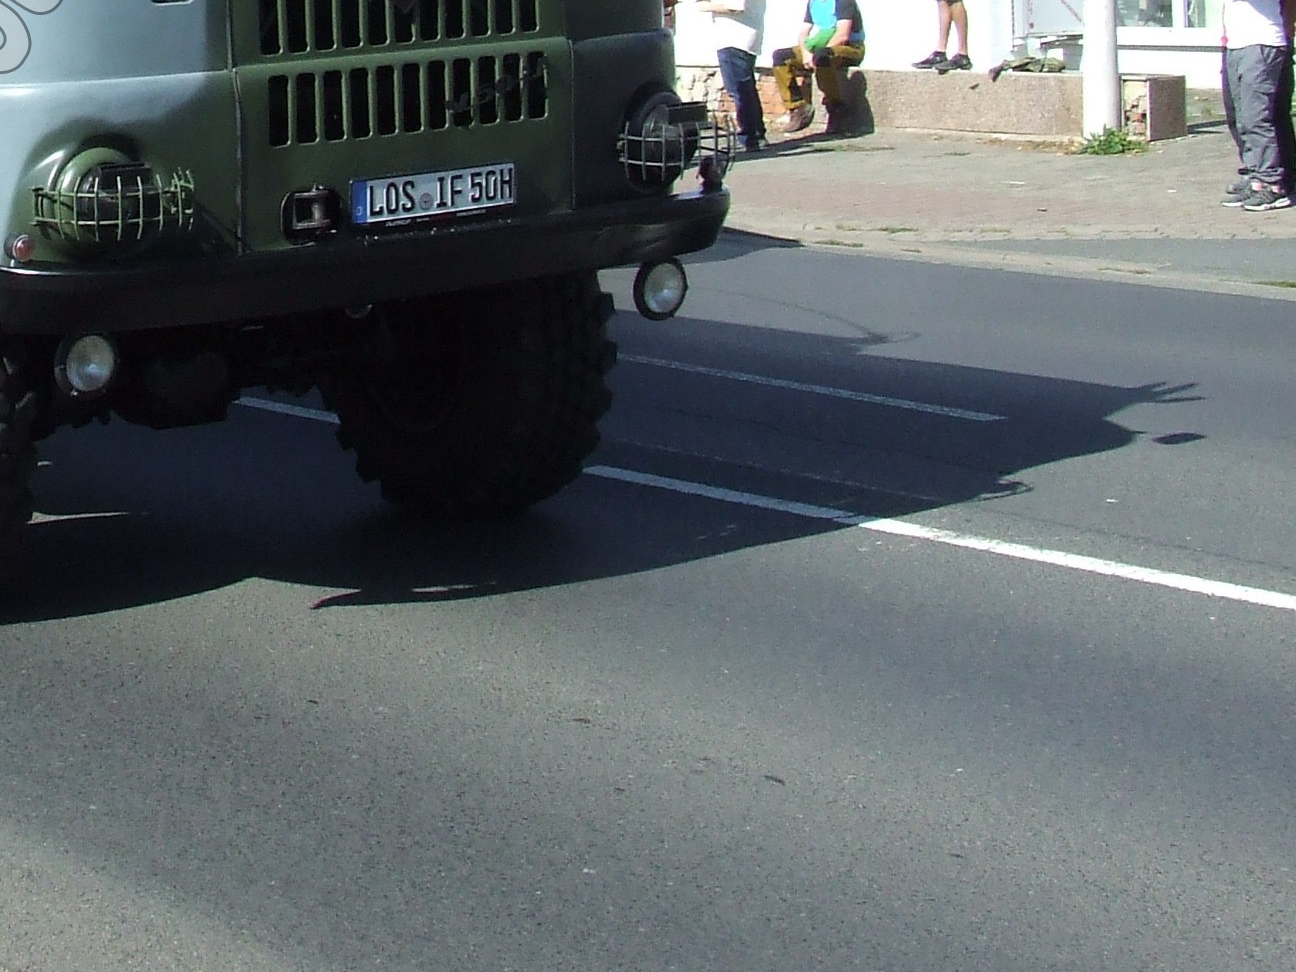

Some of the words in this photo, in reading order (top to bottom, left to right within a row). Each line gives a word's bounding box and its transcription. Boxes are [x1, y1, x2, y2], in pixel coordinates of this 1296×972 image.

[369, 180, 415, 217] LOS
[436, 174, 463, 209] IF
[470, 168, 513, 203] 50H
